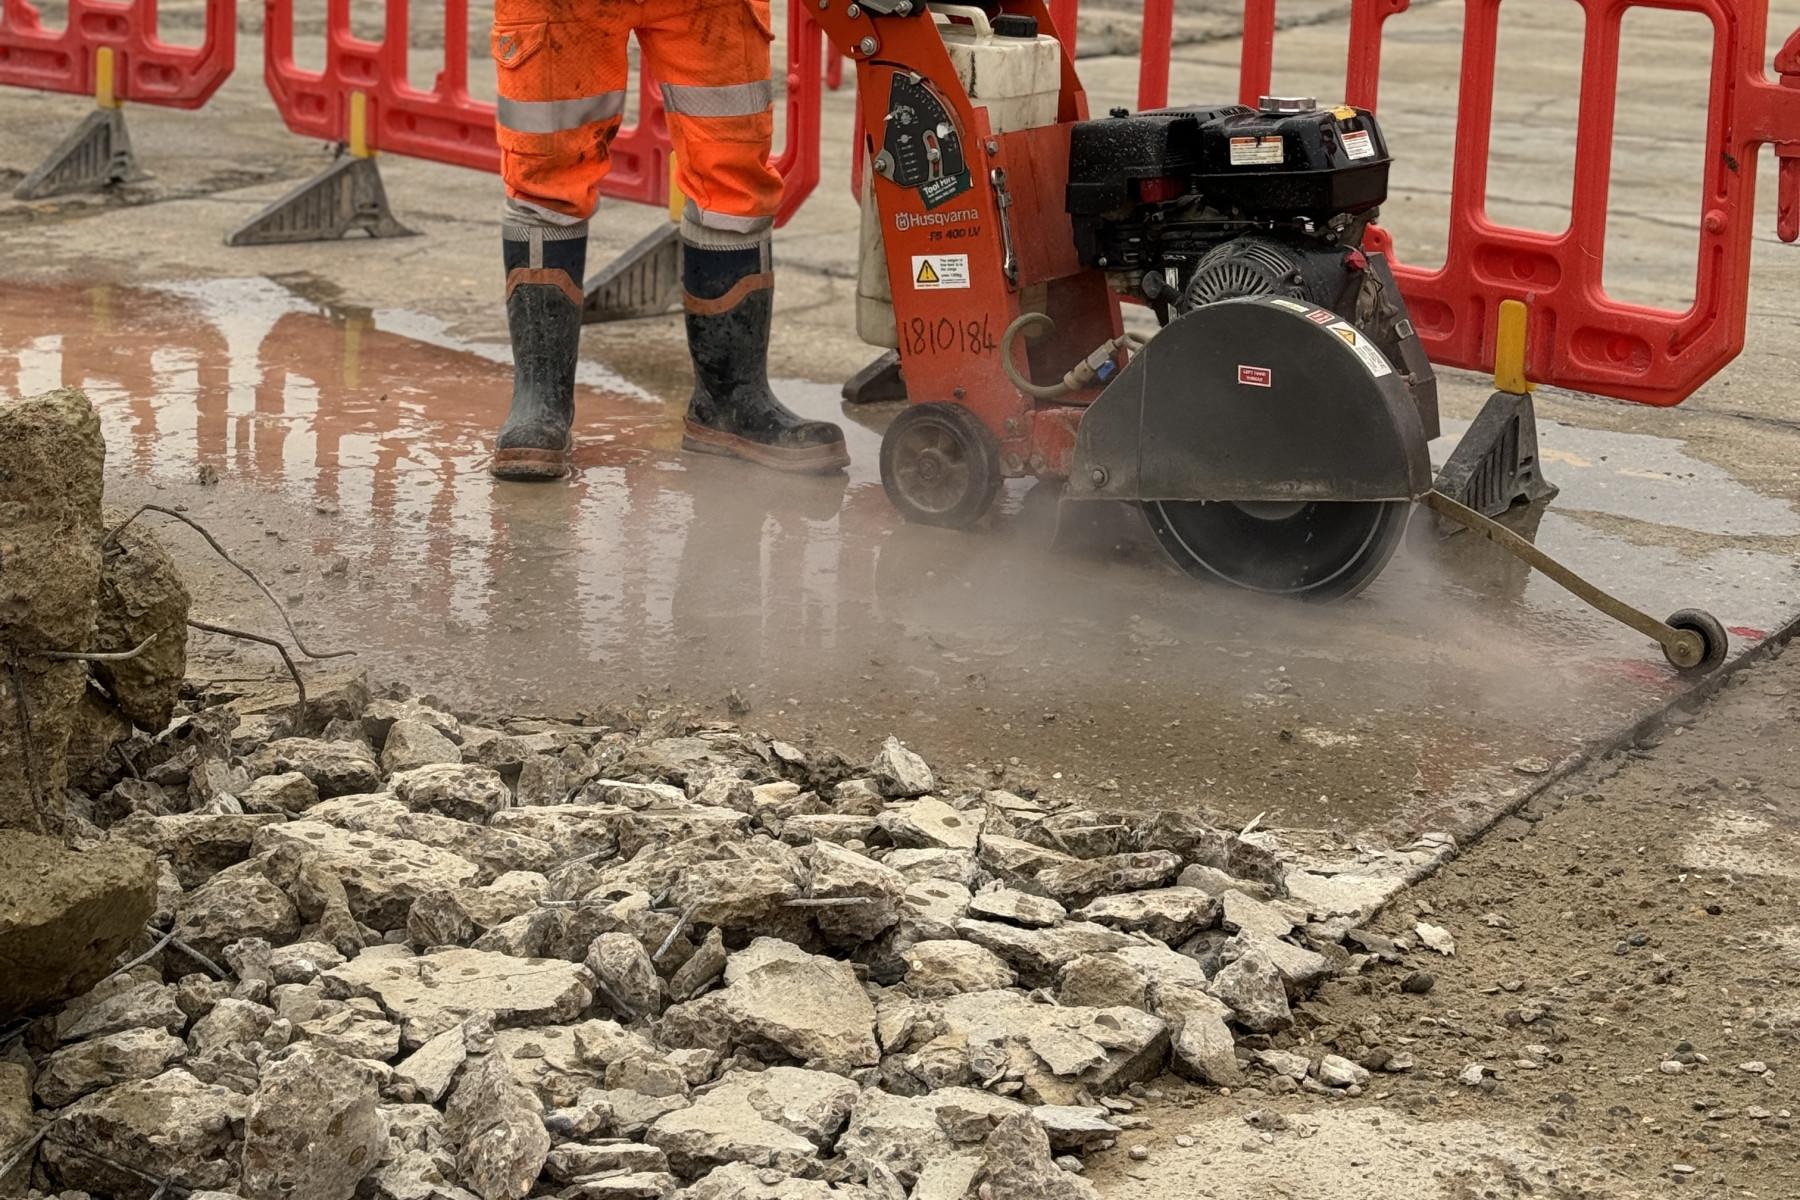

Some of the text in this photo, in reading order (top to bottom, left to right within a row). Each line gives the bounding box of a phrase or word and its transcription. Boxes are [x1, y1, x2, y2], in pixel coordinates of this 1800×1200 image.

[922, 181, 940, 195] Tool
[909, 208, 978, 227] Husqvarna
[946, 228, 965, 239] 400
[903, 313, 997, 357] 1810184
